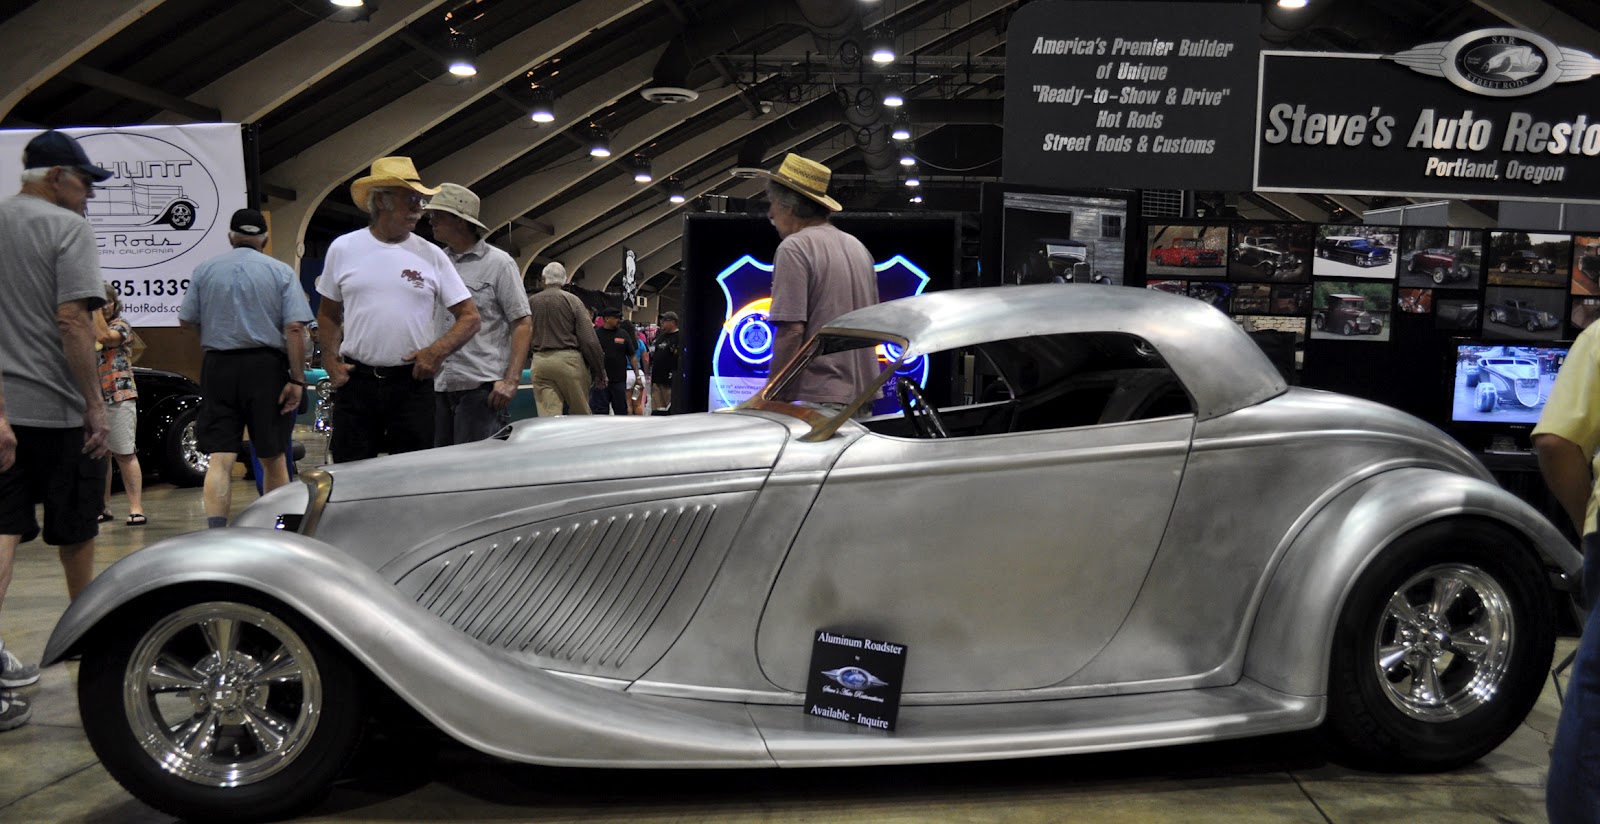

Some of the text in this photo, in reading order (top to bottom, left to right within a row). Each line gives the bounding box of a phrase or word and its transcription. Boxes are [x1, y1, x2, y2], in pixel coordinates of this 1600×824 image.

[1032, 36, 1234, 57] America's Premier Builder
[1491, 36, 1515, 45] SAR
[1096, 62, 1168, 83] of Unique
[1465, 73, 1528, 89] STREET RODS
[1165, 87, 1177, 105] &
[1181, 88, 1230, 106] Drive"
[1096, 110, 1164, 129] Hot Rods
[1264, 102, 1600, 156] Steve's Auto Resto
[1042, 133, 1216, 154] Street Rods & Customs
[1425, 156, 1565, 185] Portland, Oregon
[114, 234, 182, 247] Rods
[110, 279, 191, 296] 85.1339
[121, 303, 181, 313] HotRods.co
[818, 632, 903, 655] Aluminum Roadster
[811, 704, 850, 721] Available
[857, 713, 889, 729] Inquire
